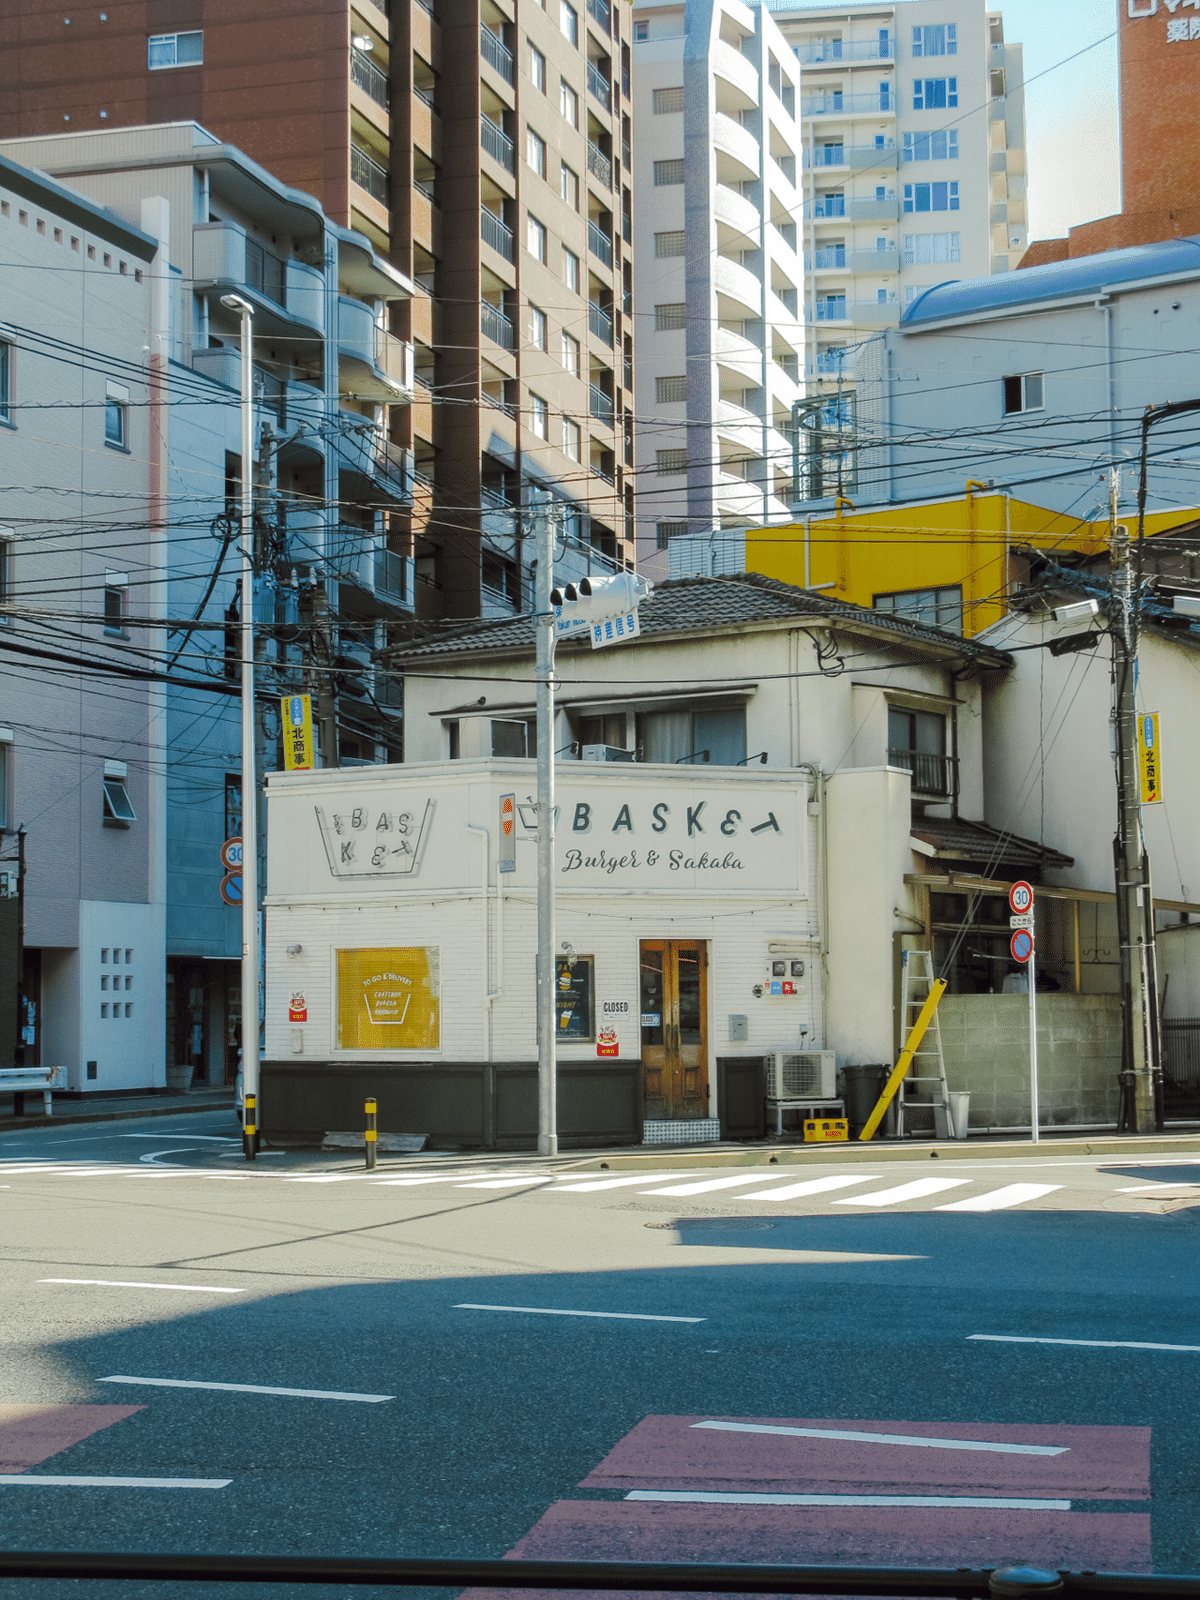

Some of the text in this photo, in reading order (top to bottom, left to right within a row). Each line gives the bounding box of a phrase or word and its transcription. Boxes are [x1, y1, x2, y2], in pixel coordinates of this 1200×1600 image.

[292, 728, 305, 765] 北商事
[1146, 750, 1155, 792] 北商事
[572, 801, 782, 837] BASKET
[561, 849, 745, 874] Burger & Sakaba
[1015, 890, 1029, 905] 30
[1011, 917, 1032, 927] ここから
[363, 978, 371, 986] TO
[371, 974, 381, 982] GO
[388, 973, 413, 986] DELIVERY
[604, 1002, 628, 1013] CLOSED
